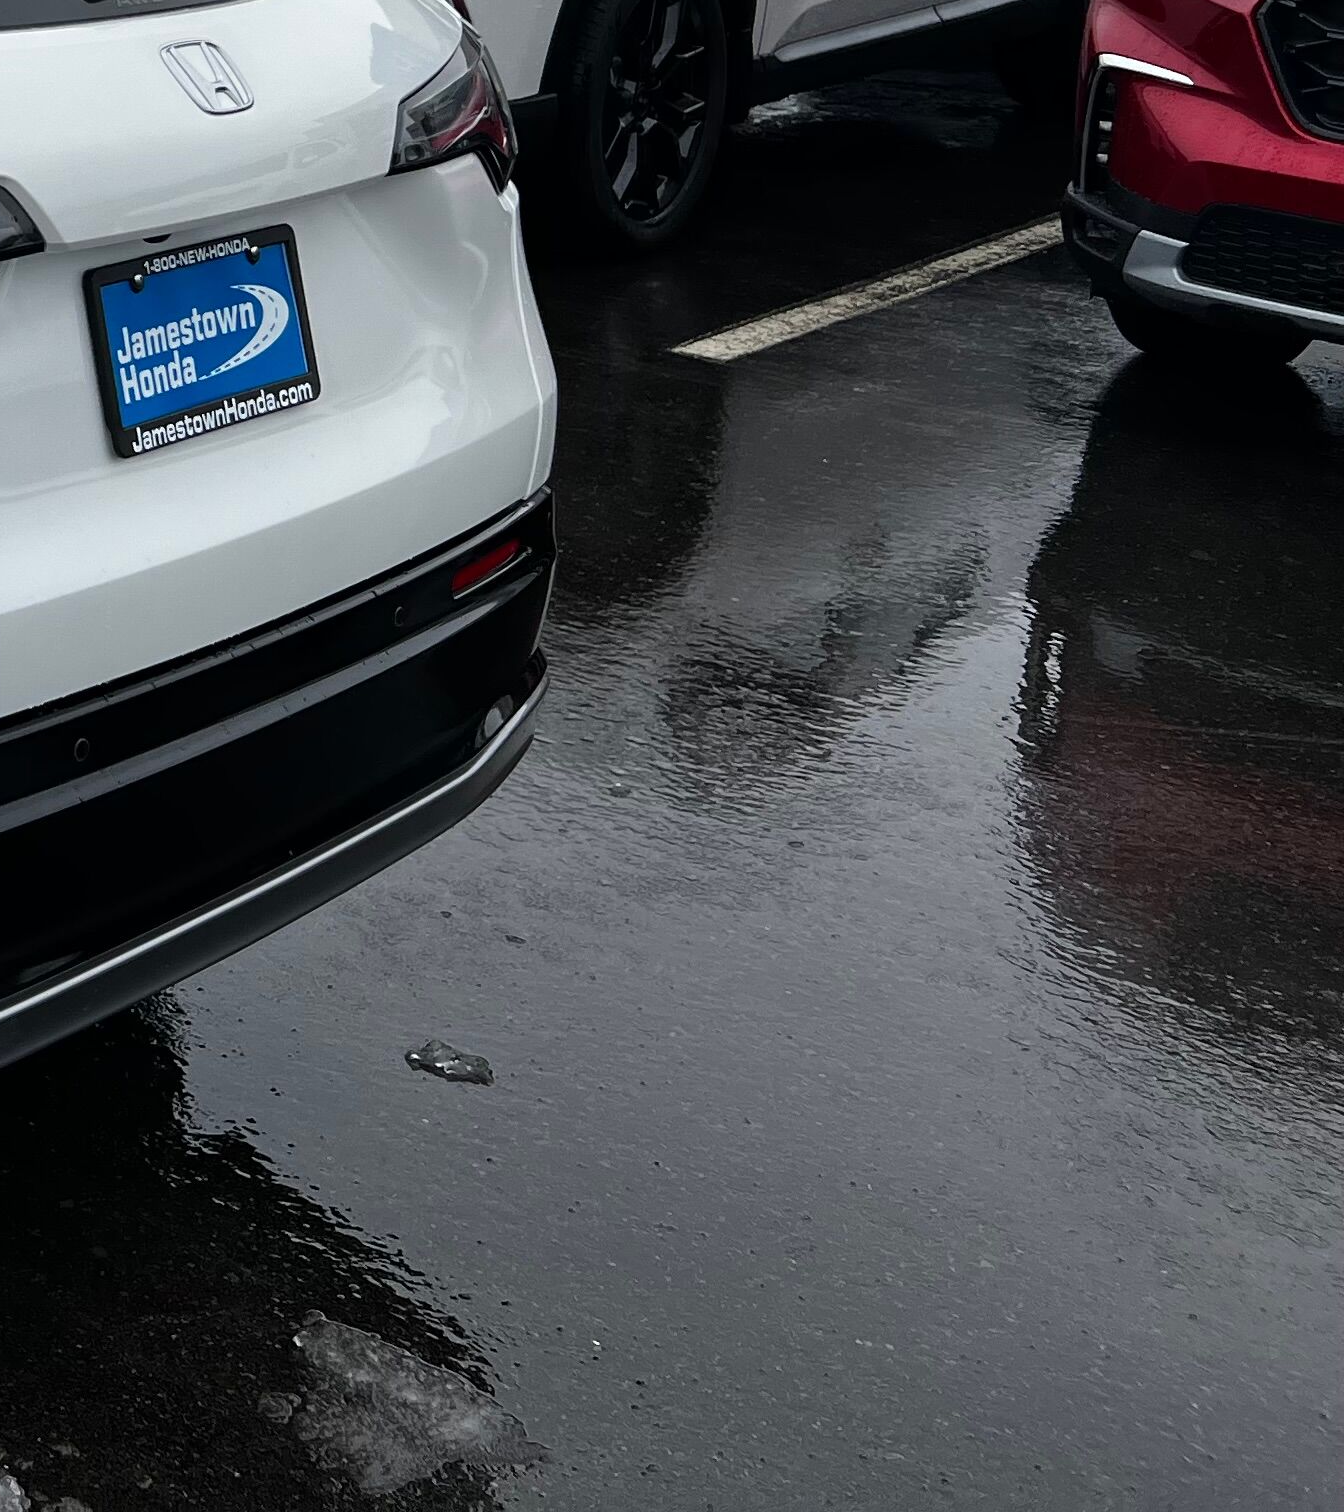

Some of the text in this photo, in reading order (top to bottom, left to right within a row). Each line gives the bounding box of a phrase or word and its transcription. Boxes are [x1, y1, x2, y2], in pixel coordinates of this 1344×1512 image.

[143, 237, 251, 275] 1-800-NEW-HONDA
[117, 301, 256, 364] Jamestown
[119, 350, 198, 404] Honda
[132, 381, 313, 453] JamestownHonda.com
